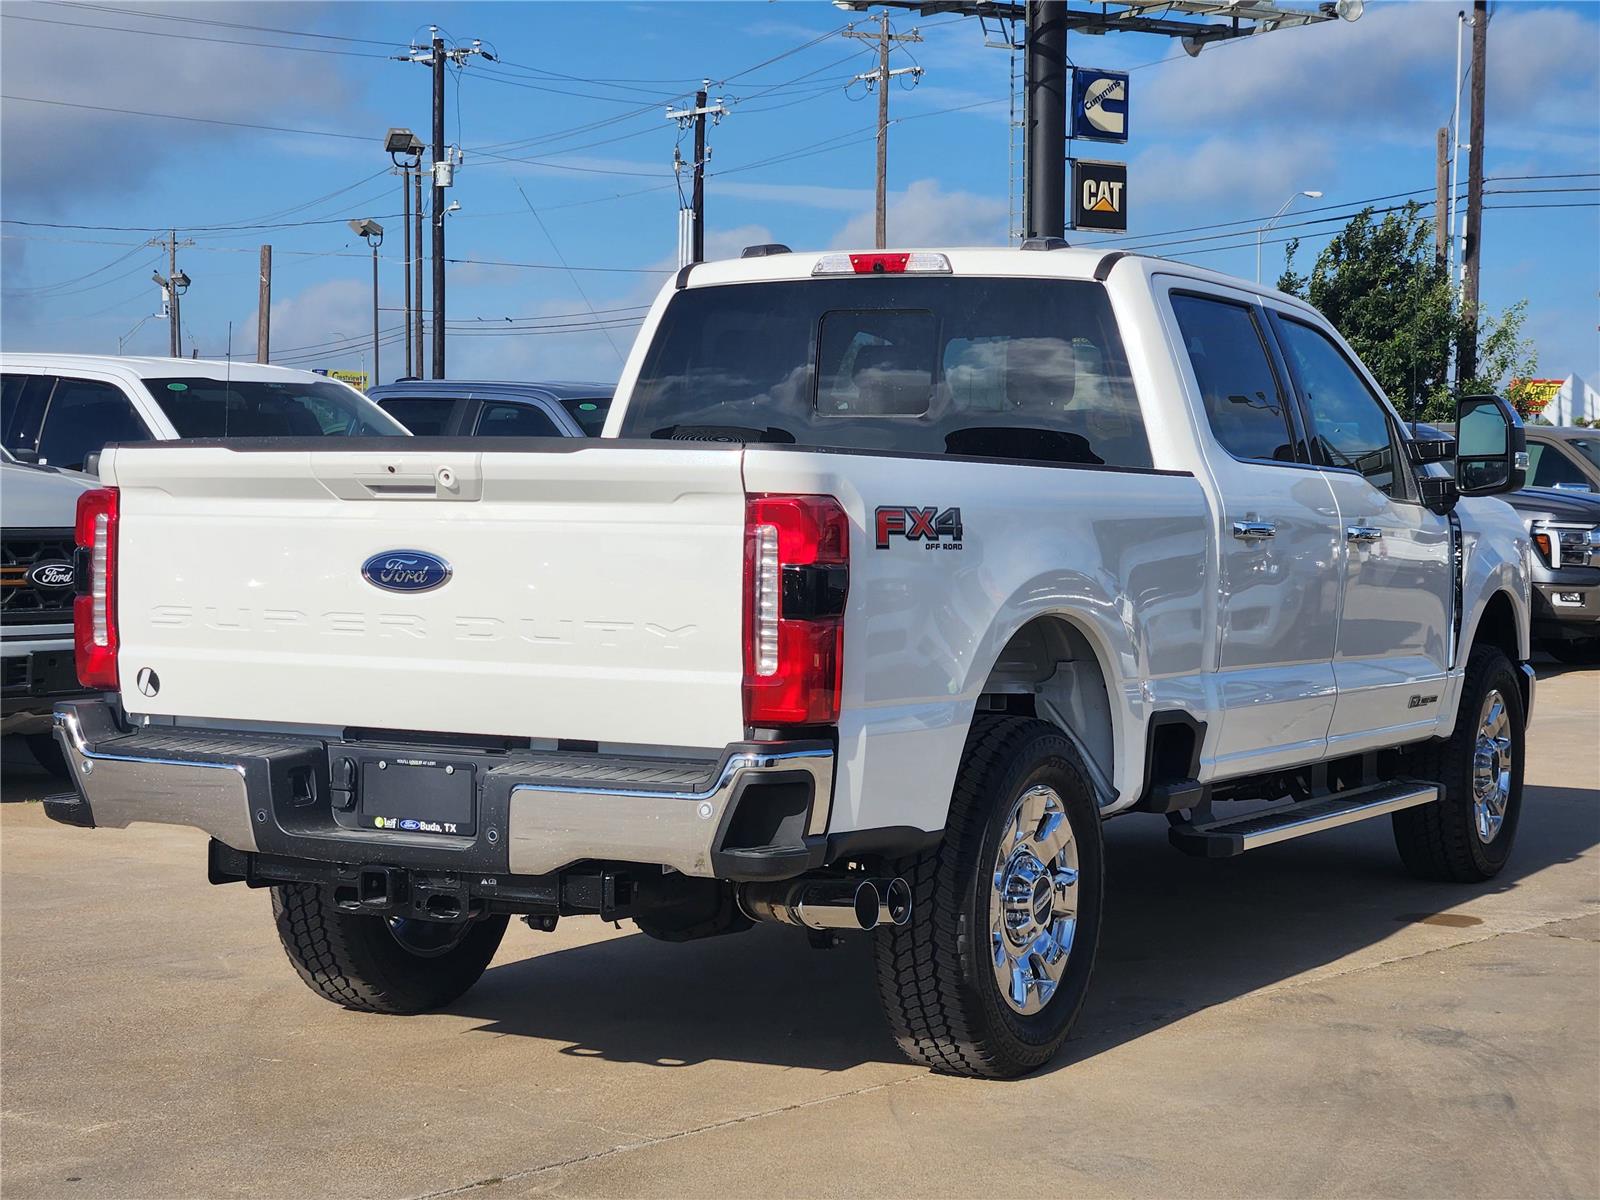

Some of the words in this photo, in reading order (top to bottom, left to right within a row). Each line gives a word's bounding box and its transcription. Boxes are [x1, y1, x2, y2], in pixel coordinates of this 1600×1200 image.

[1084, 79, 1121, 111] Cummins
[1083, 179, 1123, 213] CAT
[875, 505, 963, 550] FX4
[925, 543, 940, 551] OFF
[943, 543, 963, 551] ROAD
[42, 567, 74, 583] Ford
[380, 558, 429, 583] Ford
[150, 604, 427, 640] SUPER
[455, 615, 698, 649] DUTY
[420, 821, 442, 833] Buda,
[444, 823, 457, 833] TX
